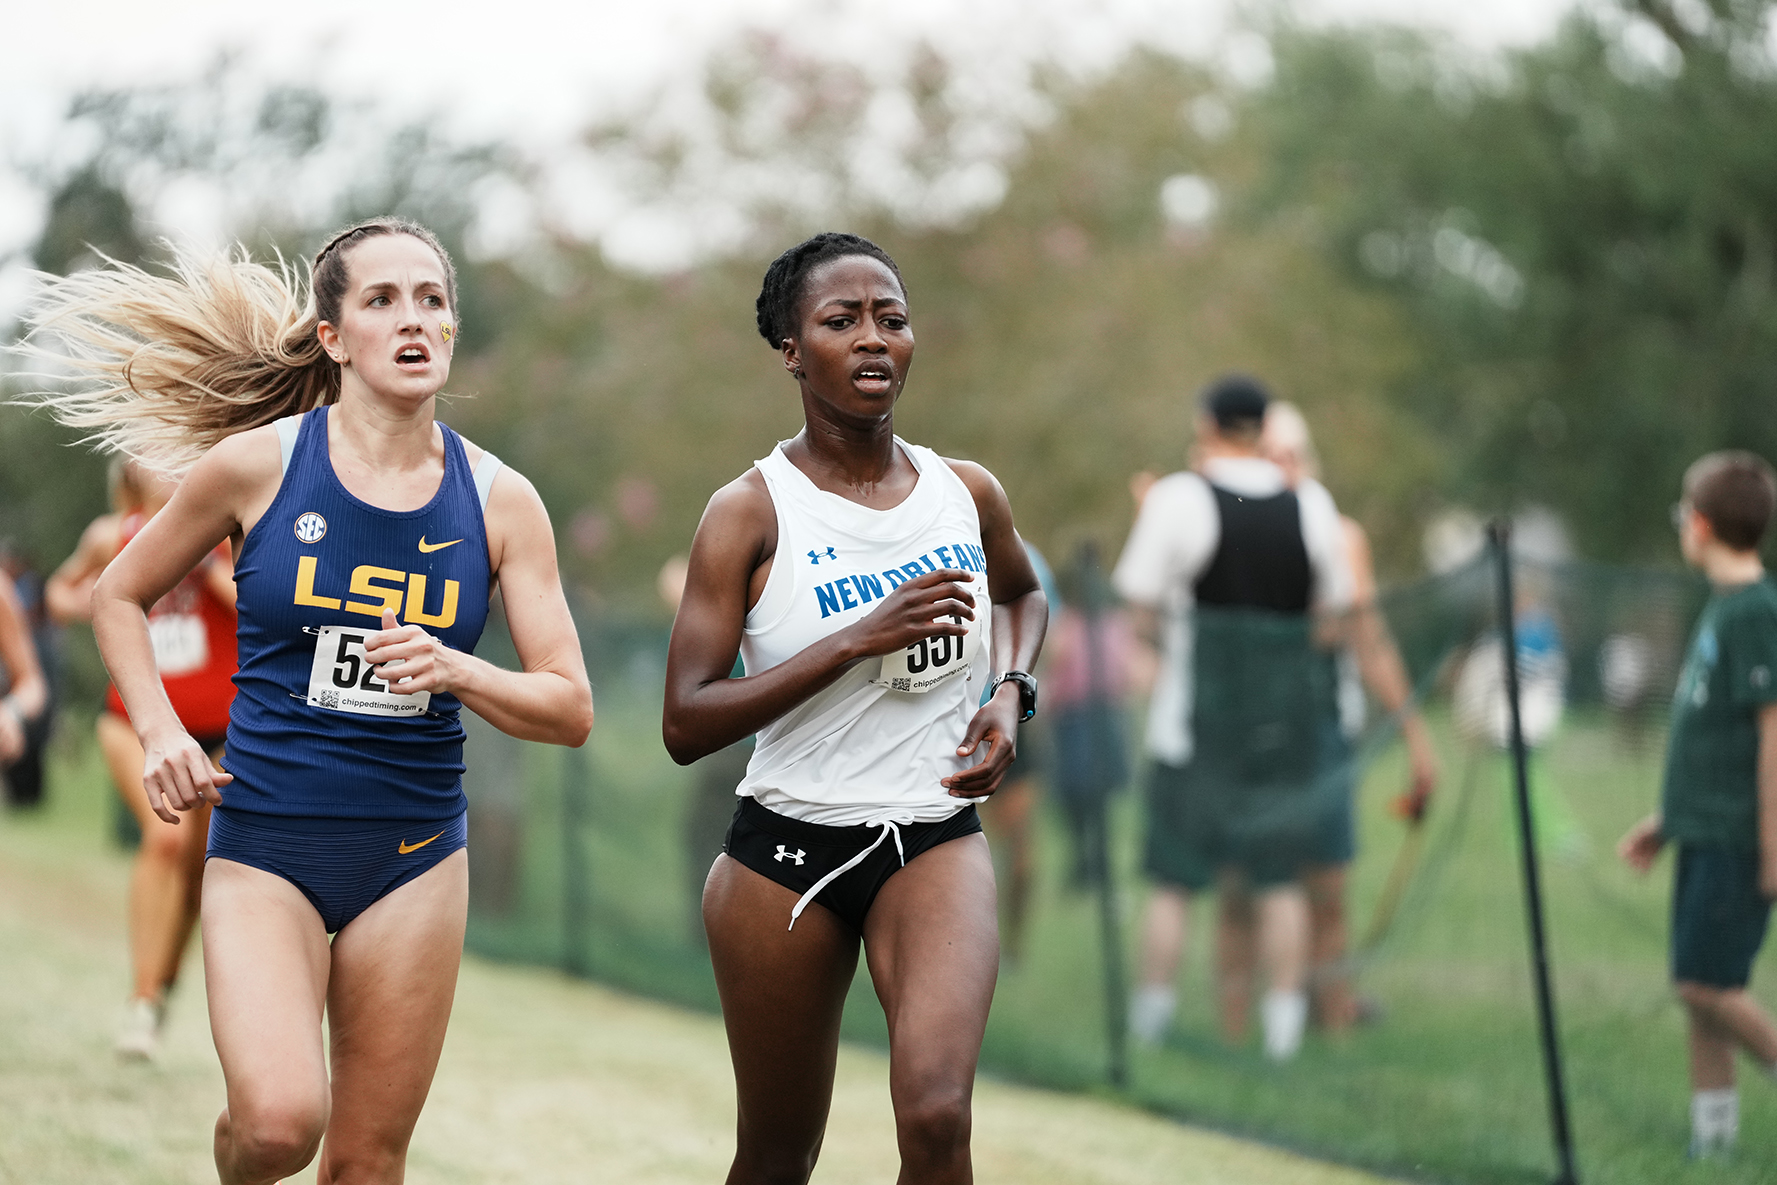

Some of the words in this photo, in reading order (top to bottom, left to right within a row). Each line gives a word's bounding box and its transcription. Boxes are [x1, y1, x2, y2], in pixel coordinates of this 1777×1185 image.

[297, 514, 324, 541] SEC
[294, 556, 460, 629] LSU
[813, 573, 885, 619] NEW
[332, 633, 413, 695] 52
[341, 698, 417, 712] chippedtiming.com
